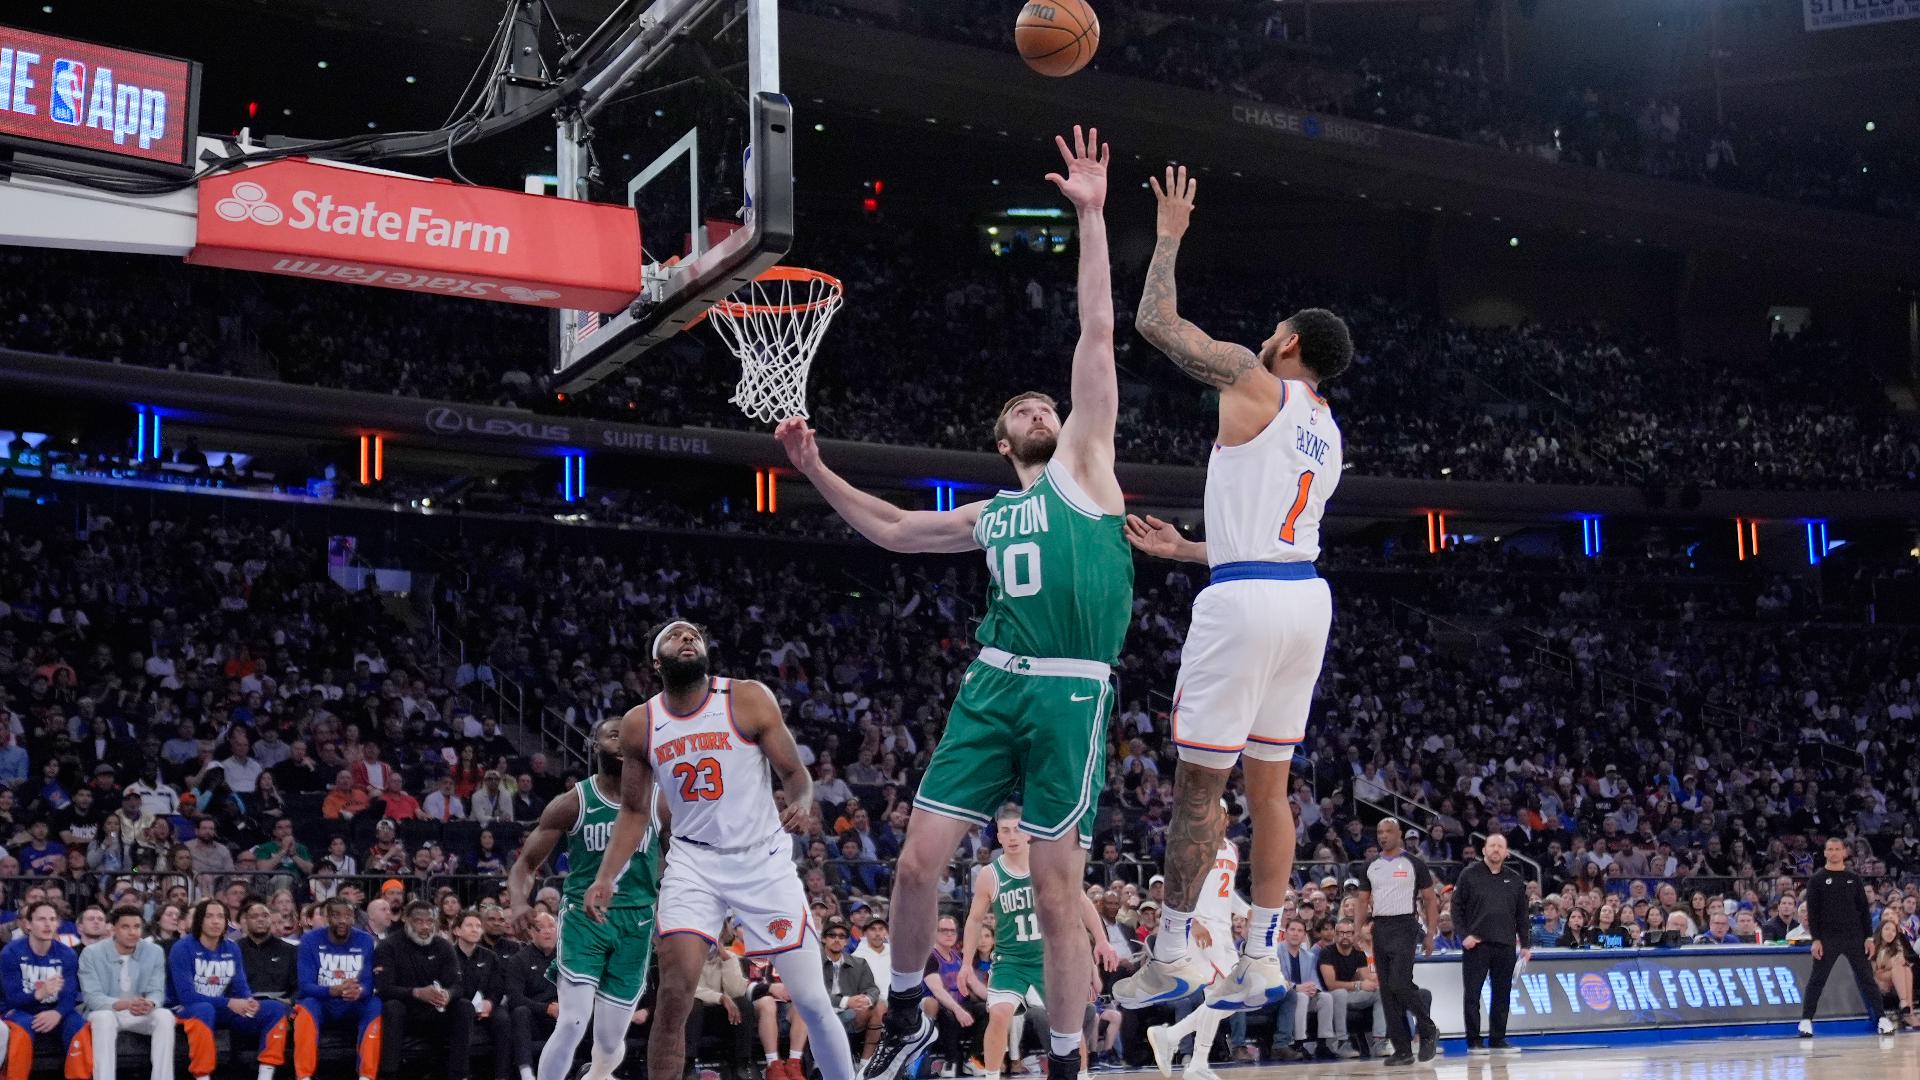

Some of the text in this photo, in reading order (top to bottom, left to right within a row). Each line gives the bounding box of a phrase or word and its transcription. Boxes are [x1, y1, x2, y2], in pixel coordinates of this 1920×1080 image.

[0, 48, 167, 149] E App
[1232, 105, 1299, 132] CHASE
[467, 416, 711, 454] LEXUS SUITE LEVEL
[1296, 425, 1330, 466] PAYNE
[978, 495, 1049, 547] OSTON
[1279, 469, 1315, 545] 1
[654, 732, 733, 766] NEW YORK
[672, 757, 724, 802] 23
[1218, 873, 1230, 897] 2
[1014, 912, 1042, 942] 11
[195, 958, 236, 977] WIN
[318, 952, 363, 972] WIN
[1658, 966, 1801, 1009] FOREVER
